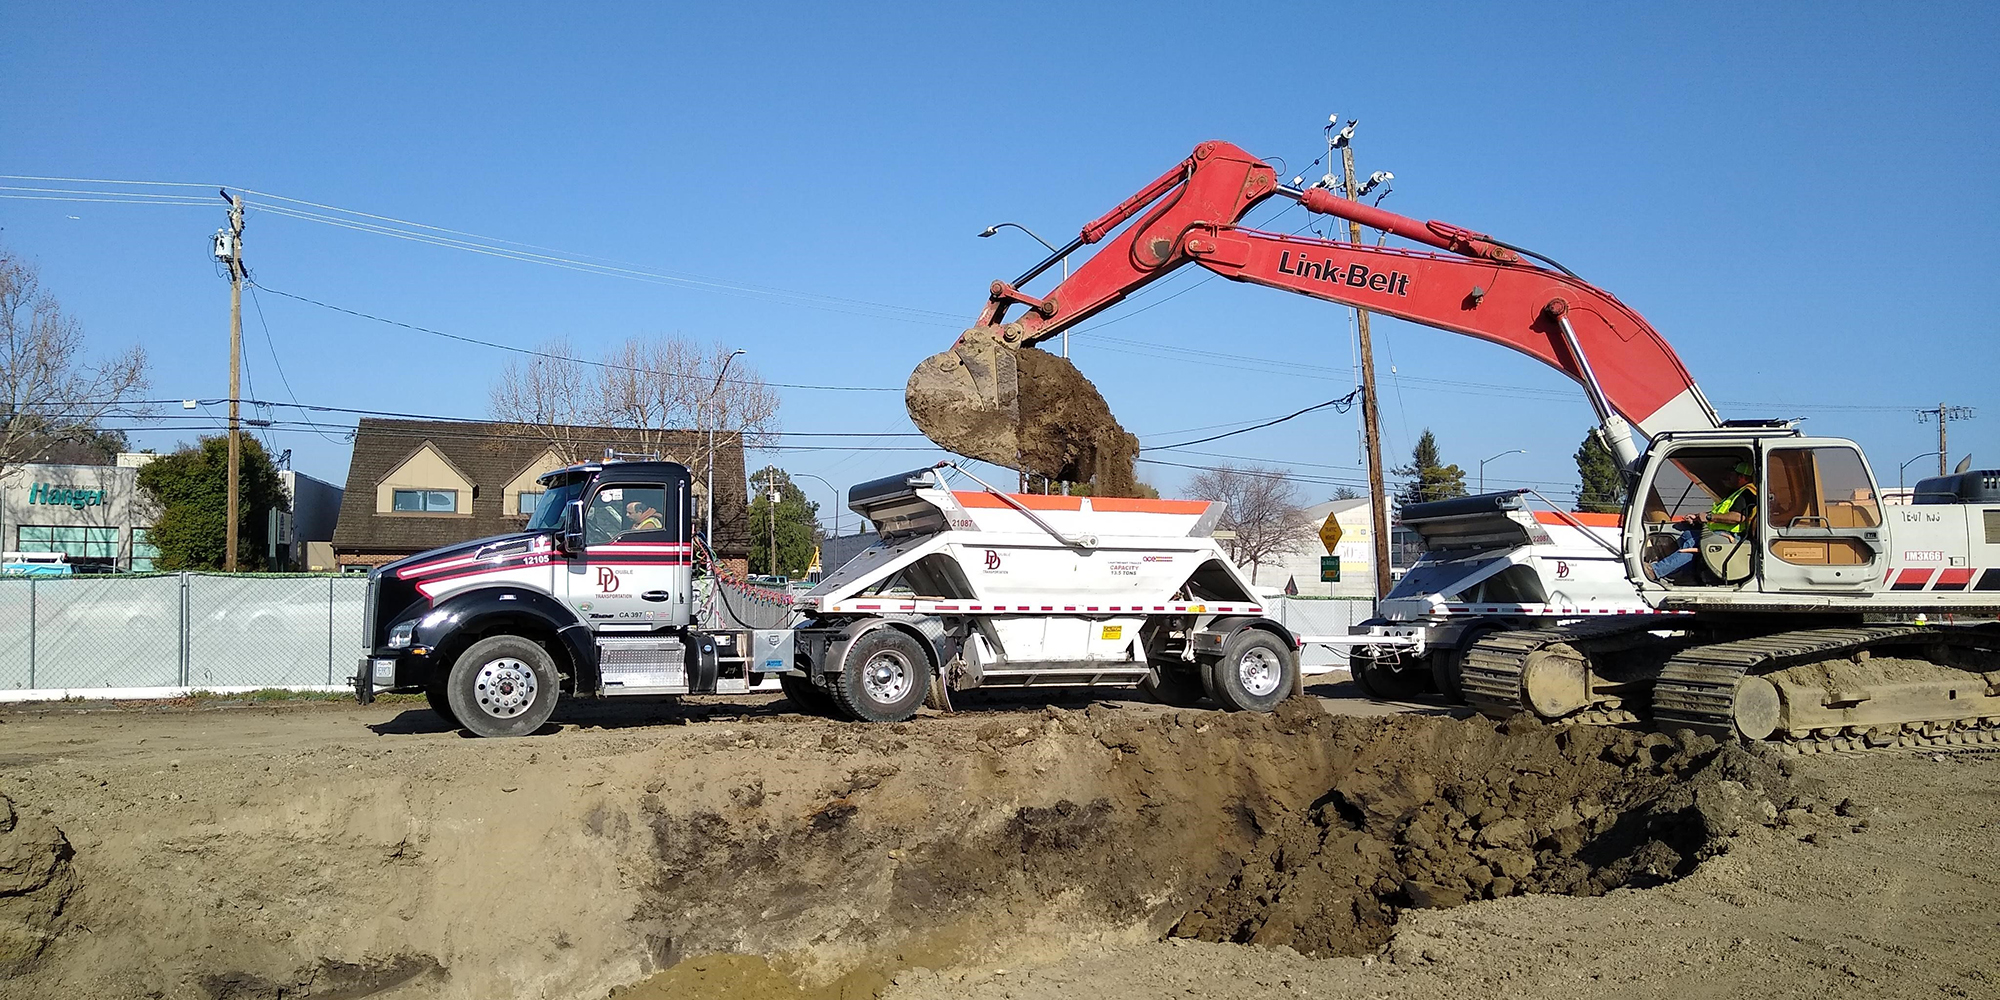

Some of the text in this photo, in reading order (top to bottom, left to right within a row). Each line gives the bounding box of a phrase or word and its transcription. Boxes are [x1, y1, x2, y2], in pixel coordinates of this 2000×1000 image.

[1278, 250, 1410, 297] Link-Belt
[28, 482, 107, 510] Hanger
[952, 519, 973, 527] 21087
[523, 555, 550, 565] 12105
[1906, 551, 1941, 561] JM3X66
